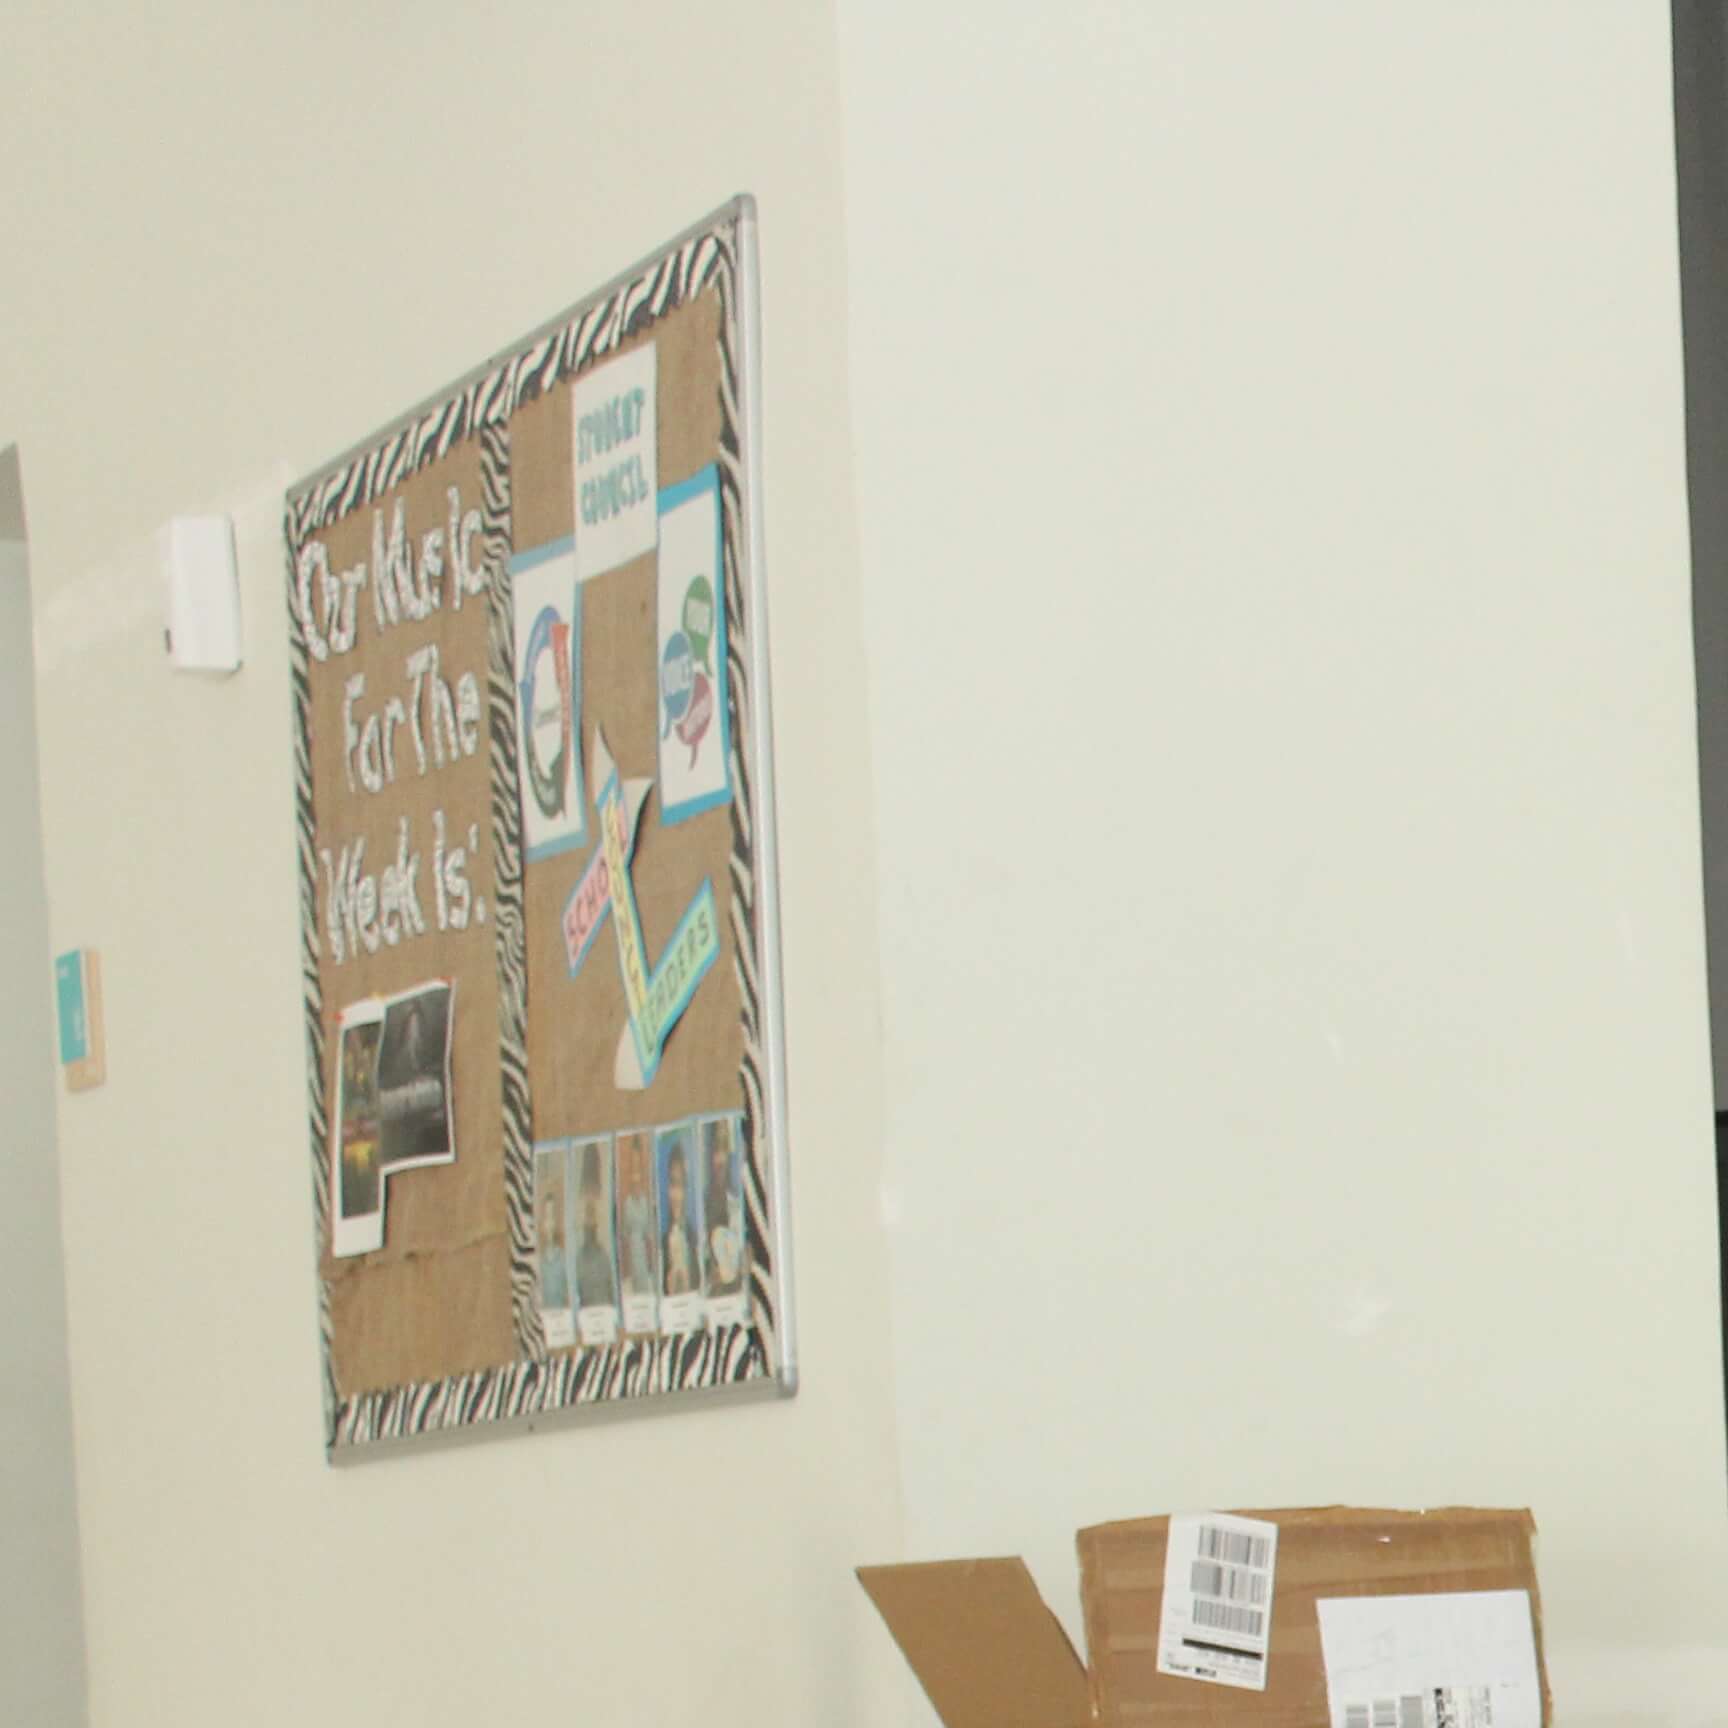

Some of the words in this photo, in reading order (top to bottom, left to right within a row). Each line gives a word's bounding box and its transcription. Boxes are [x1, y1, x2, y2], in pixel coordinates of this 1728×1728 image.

[297, 540, 368, 662] Our
[344, 672, 406, 793] For
[405, 643, 480, 777] The
[320, 815, 426, 965] Week
[641, 910, 711, 1056] LEADERS
